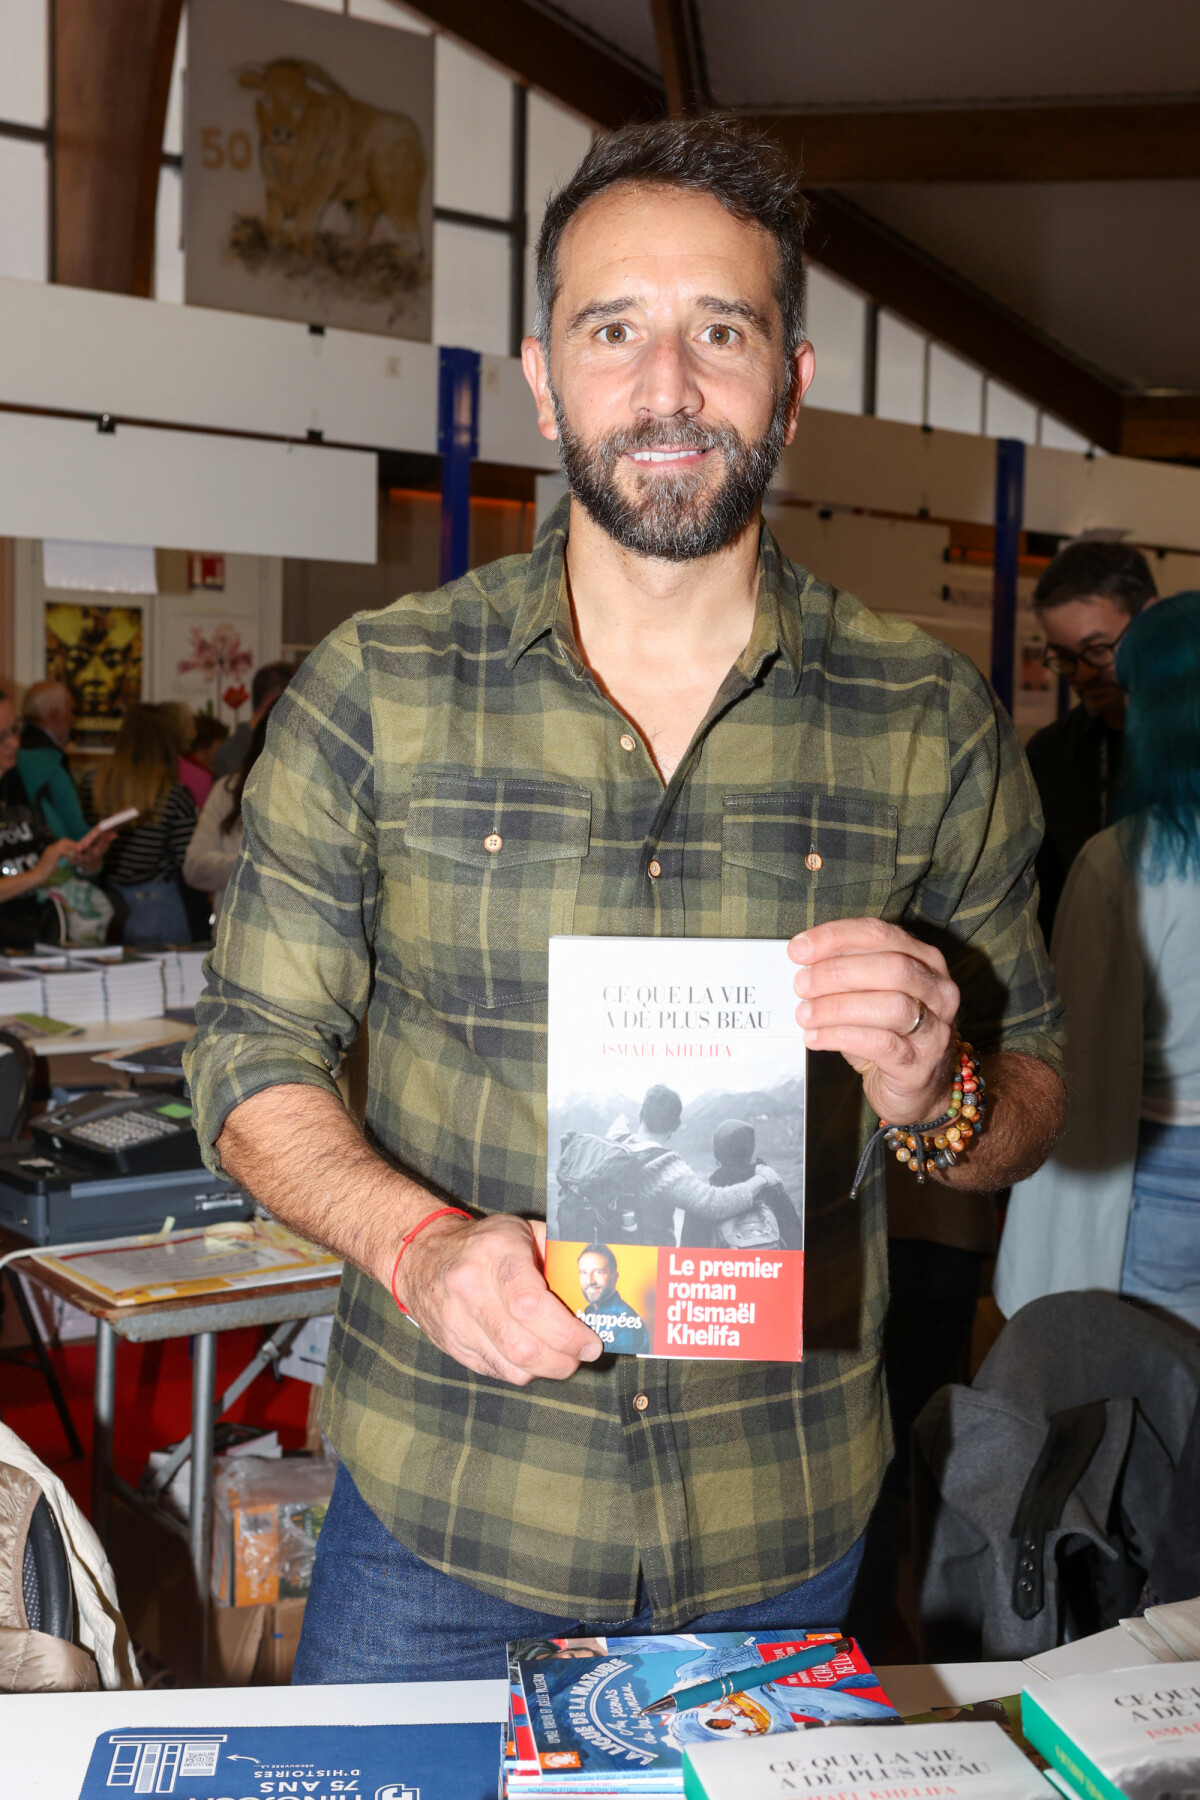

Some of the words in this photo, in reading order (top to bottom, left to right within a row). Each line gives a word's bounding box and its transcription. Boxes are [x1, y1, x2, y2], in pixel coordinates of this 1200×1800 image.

[200, 127, 253, 171] 50
[602, 985, 630, 1004] CE
[636, 985, 682, 1008] QUE
[688, 986, 714, 1005] LA
[720, 986, 757, 1005] VIE
[603, 1010, 616, 1029] A
[623, 1010, 652, 1029] DE
[658, 1010, 711, 1030] PLUS
[716, 1010, 772, 1030] BEAU
[602, 1040, 660, 1057] ISMAËL
[664, 1043, 735, 1057] KHELIFA
[669, 1253, 695, 1276] Le
[699, 1257, 783, 1282] premier
[668, 1281, 737, 1301] roman
[667, 1300, 756, 1325] d'Ismaël
[667, 1323, 741, 1347] Khelifa
[533, 1673, 549, 1693] PASSERON
[570, 1658, 628, 1696] NATURE
[568, 1696, 587, 1710] LA
[604, 1688, 628, 1718] secours
[1114, 1694, 1152, 1708] CE
[569, 1712, 589, 1725] DE
[1152, 1704, 1193, 1719] DE
[606, 1719, 634, 1736] Au
[632, 1731, 658, 1744] du
[574, 1725, 627, 1756] LIGUE
[625, 1751, 654, 1765] LA
[769, 1759, 806, 1774] CE
[811, 1752, 871, 1772] QUE
[874, 1751, 910, 1765] LA
[913, 1748, 963, 1764] VIE
[253, 1769, 361, 1779] D'HISTOIRES
[780, 1777, 797, 1790] A
[802, 1773, 843, 1787] DE
[847, 1767, 915, 1783] PLUS
[920, 1761, 992, 1779] BEAU
[259, 1780, 322, 1793] ANS
[330, 1779, 360, 1791] 75
